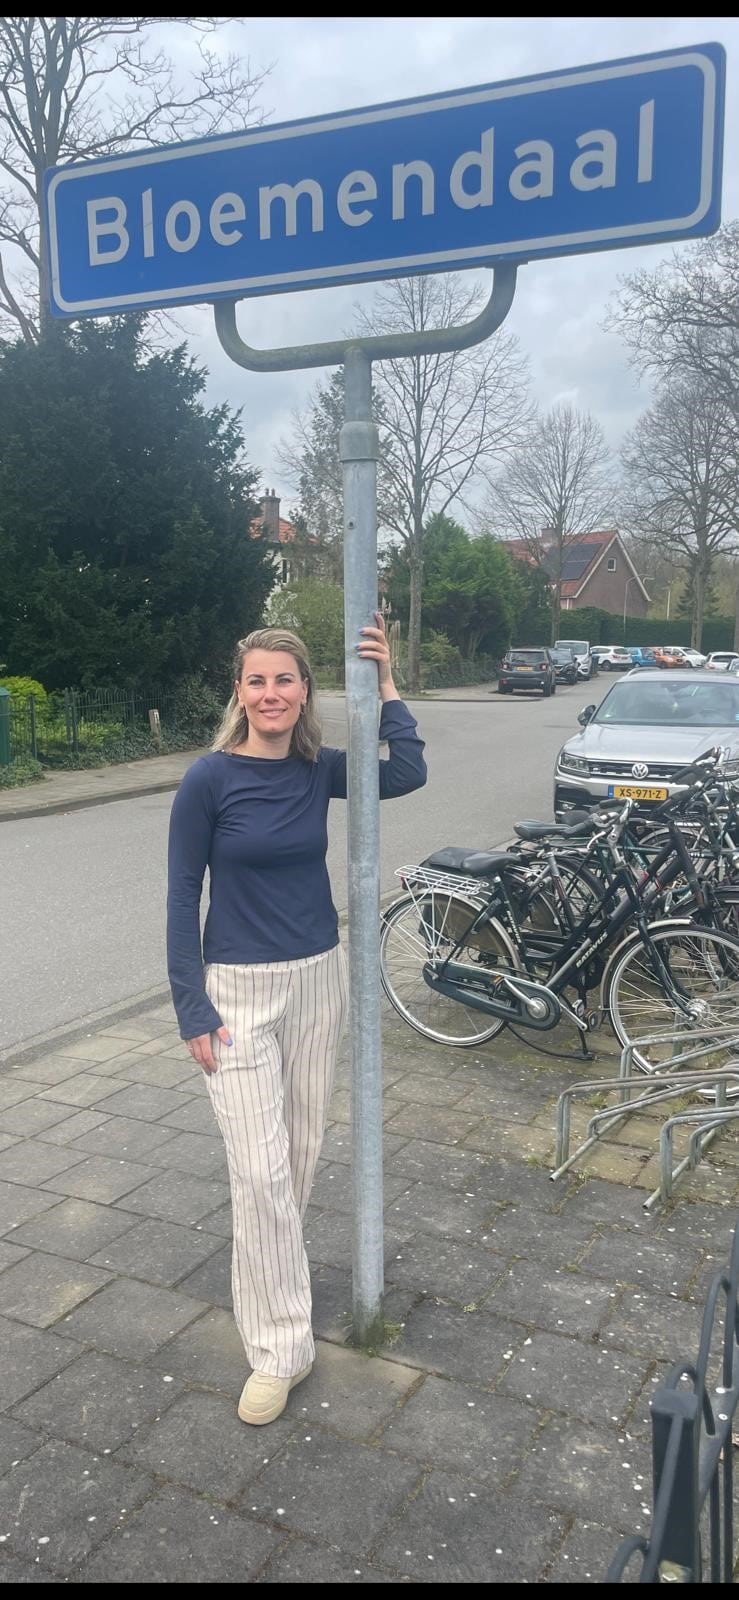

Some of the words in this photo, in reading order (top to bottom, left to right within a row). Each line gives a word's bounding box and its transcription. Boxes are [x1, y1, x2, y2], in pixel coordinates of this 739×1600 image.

[86, 99, 655, 266] Bloemendaal
[619, 788, 662, 799] XS-971-Z
[576, 931, 608, 968] BATAVUS
